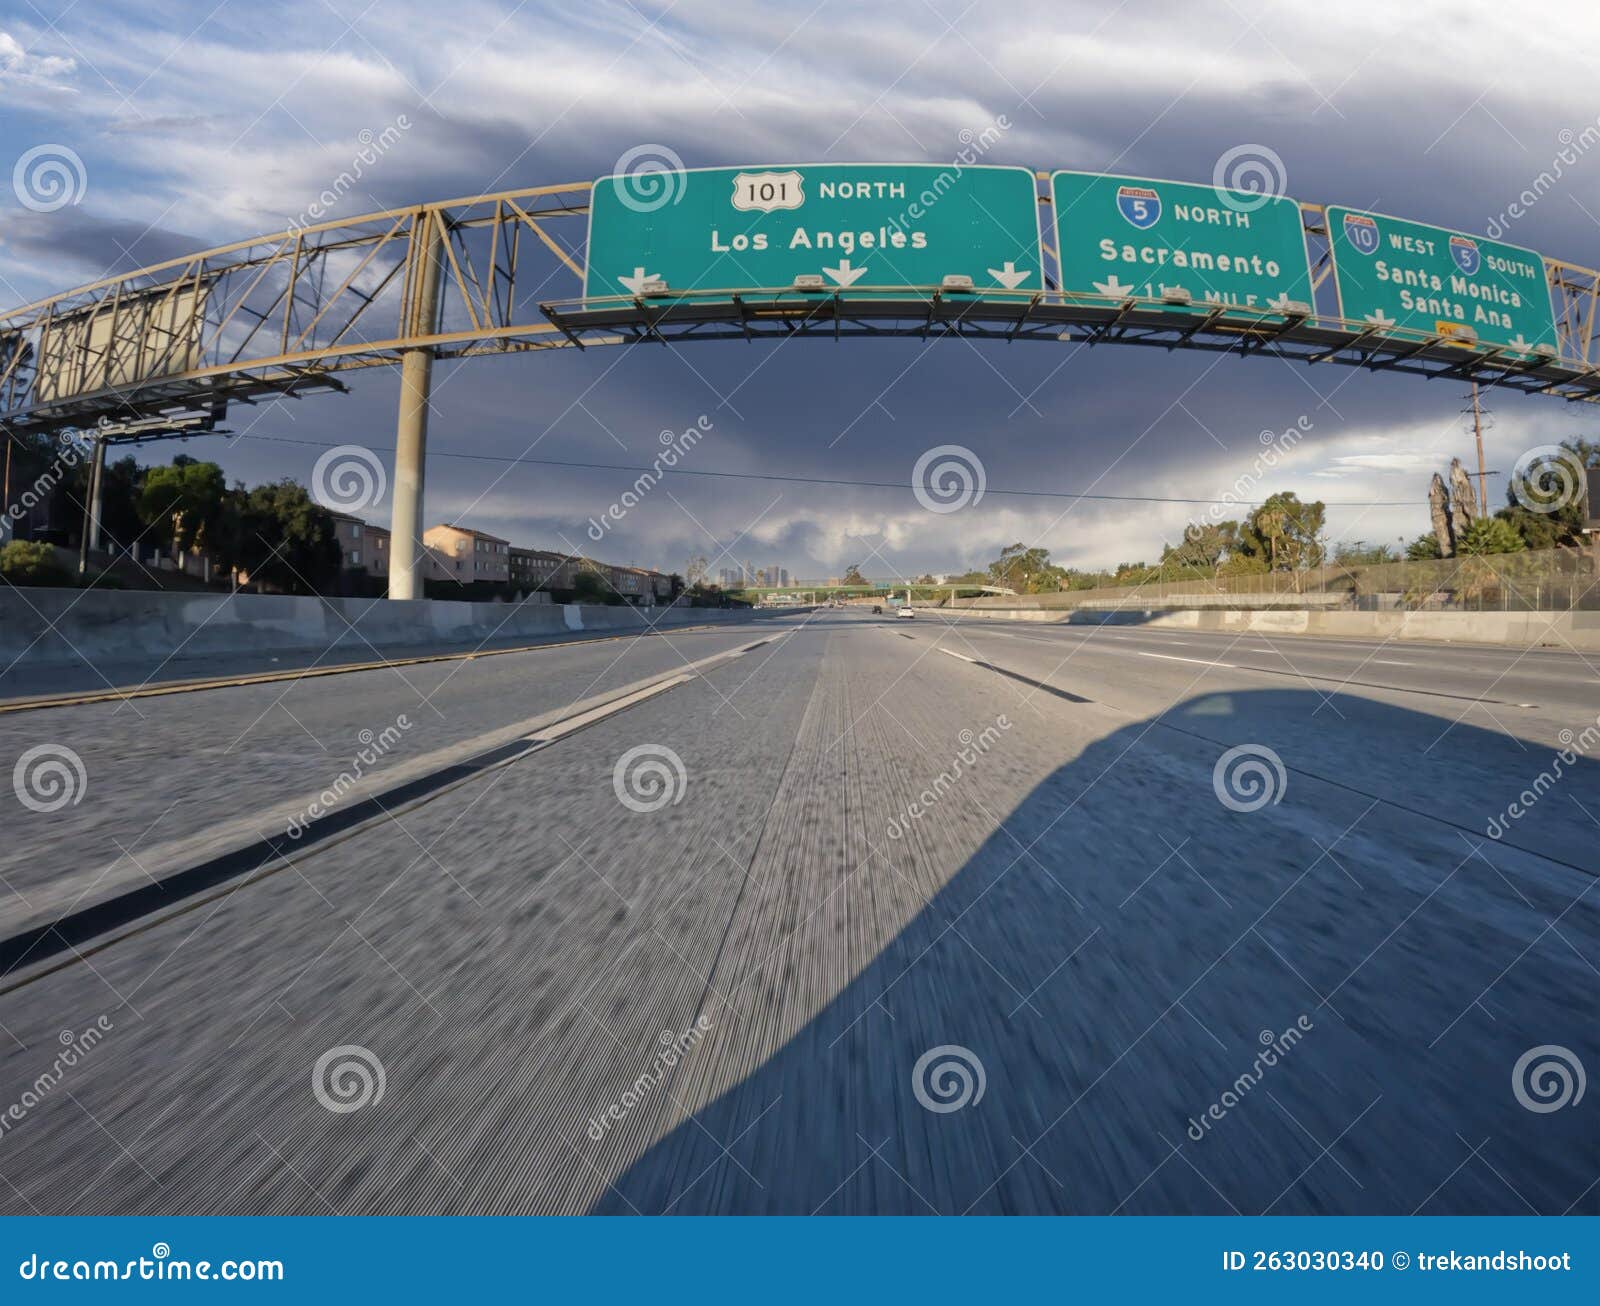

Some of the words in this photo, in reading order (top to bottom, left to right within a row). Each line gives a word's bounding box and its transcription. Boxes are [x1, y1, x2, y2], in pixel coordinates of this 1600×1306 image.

[749, 182, 787, 201] 101
[820, 182, 905, 198] NORTH
[1133, 201, 1148, 220] 5
[1175, 204, 1249, 228] NORTH
[711, 230, 768, 252] Los
[790, 227, 928, 254] Angeles
[1353, 228, 1372, 247] 10
[1389, 233, 1435, 256] WEST
[1099, 238, 1280, 278] Sacramento
[1461, 249, 1472, 267] 5
[1487, 255, 1535, 280] SOUTH
[1375, 261, 1441, 291] Santa
[1452, 276, 1521, 307] Monica
[1400, 290, 1464, 320] Santa
[1475, 305, 1512, 329] Ana
